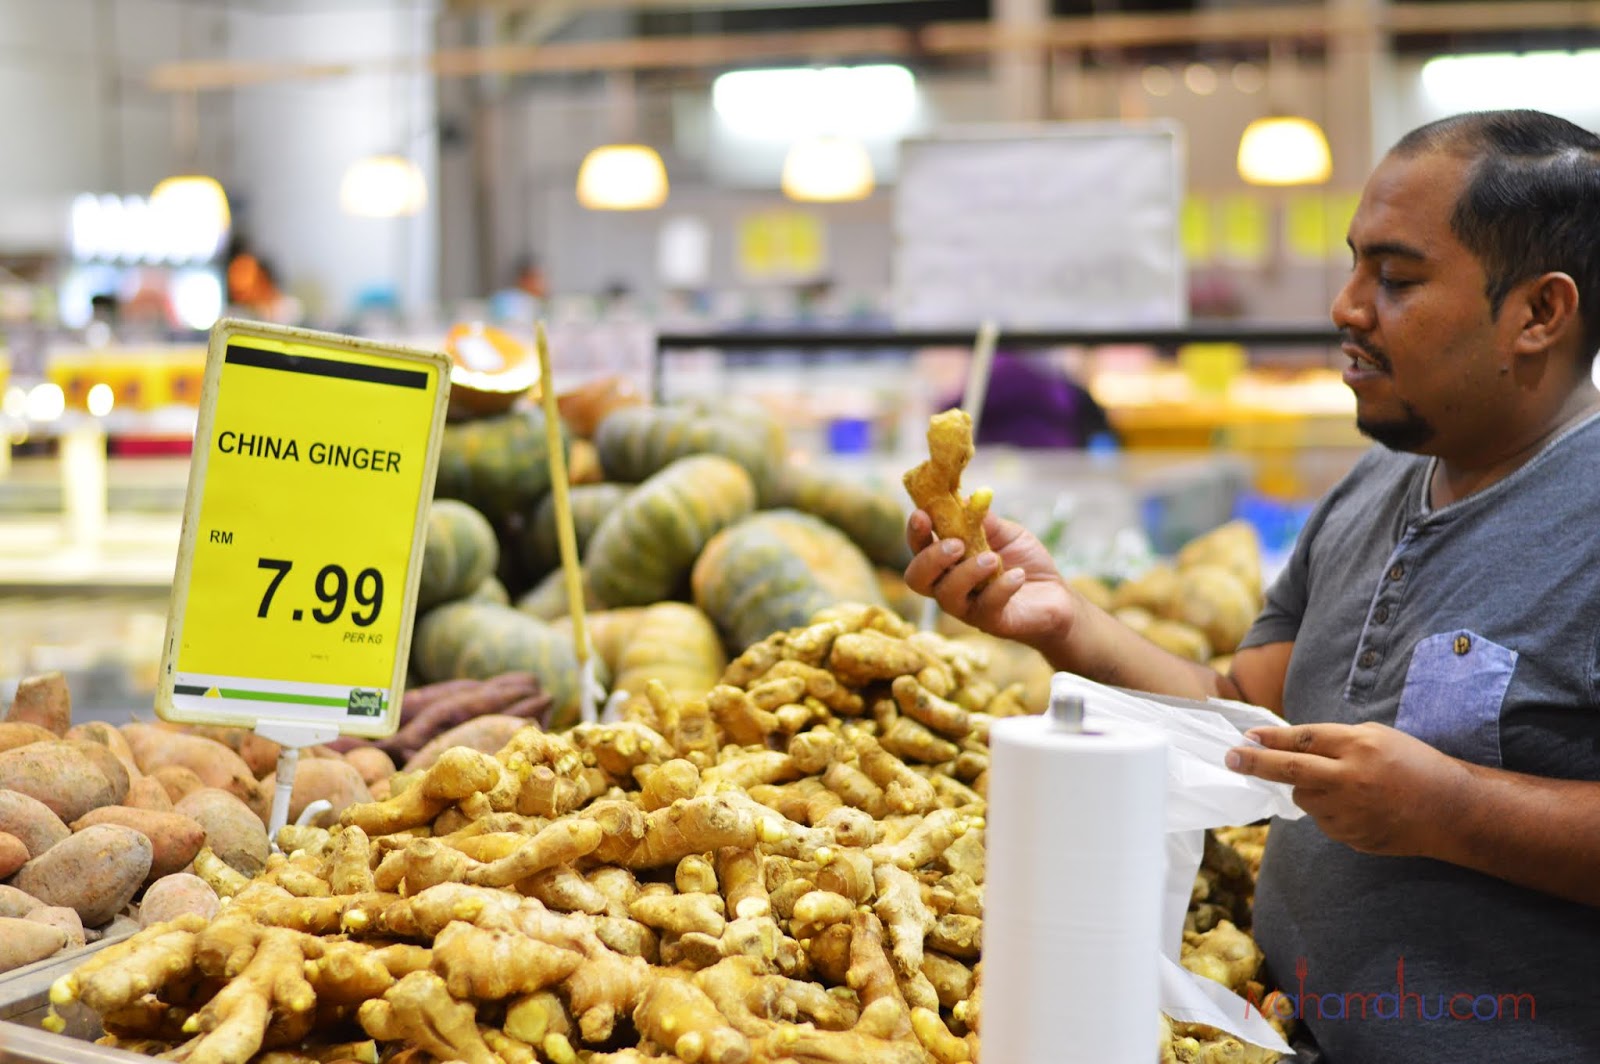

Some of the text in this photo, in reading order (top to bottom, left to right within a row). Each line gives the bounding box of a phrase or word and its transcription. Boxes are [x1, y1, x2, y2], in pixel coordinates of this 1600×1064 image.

[218, 431, 401, 473] CHINA GINGER
[209, 529, 233, 545] RM
[257, 557, 384, 627] 7.99
[342, 631, 383, 645] PER KG
